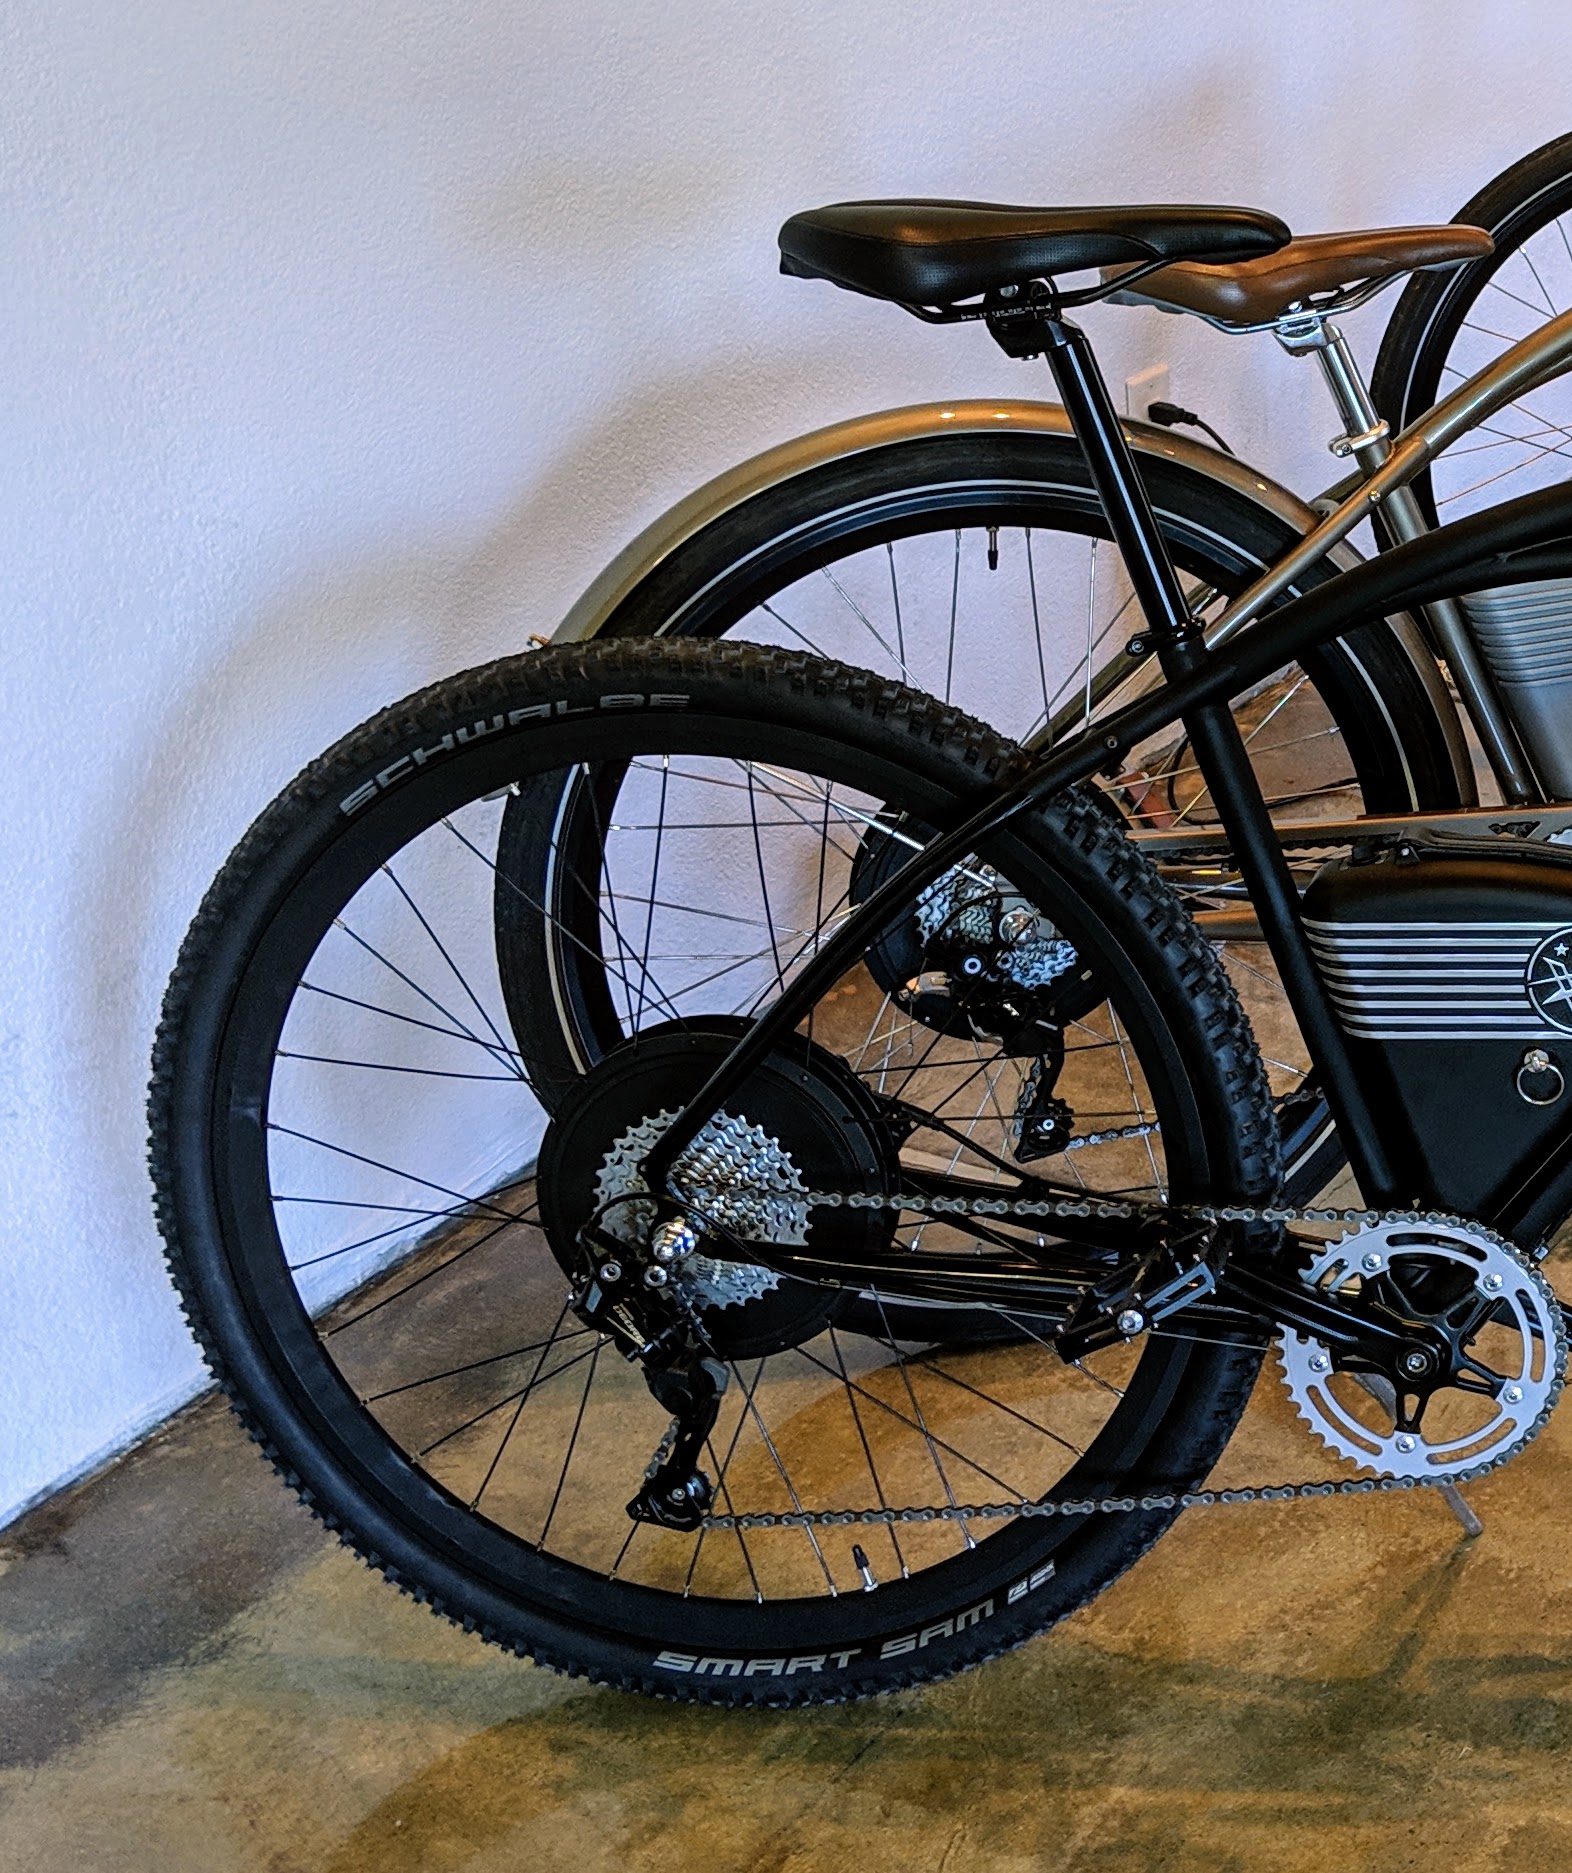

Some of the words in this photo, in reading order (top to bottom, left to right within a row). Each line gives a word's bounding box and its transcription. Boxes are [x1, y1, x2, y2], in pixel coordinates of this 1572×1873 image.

[339, 693, 691, 816] SCHWALBE
[652, 1648, 862, 1678] SMART
[880, 1599, 994, 1660] SAM
